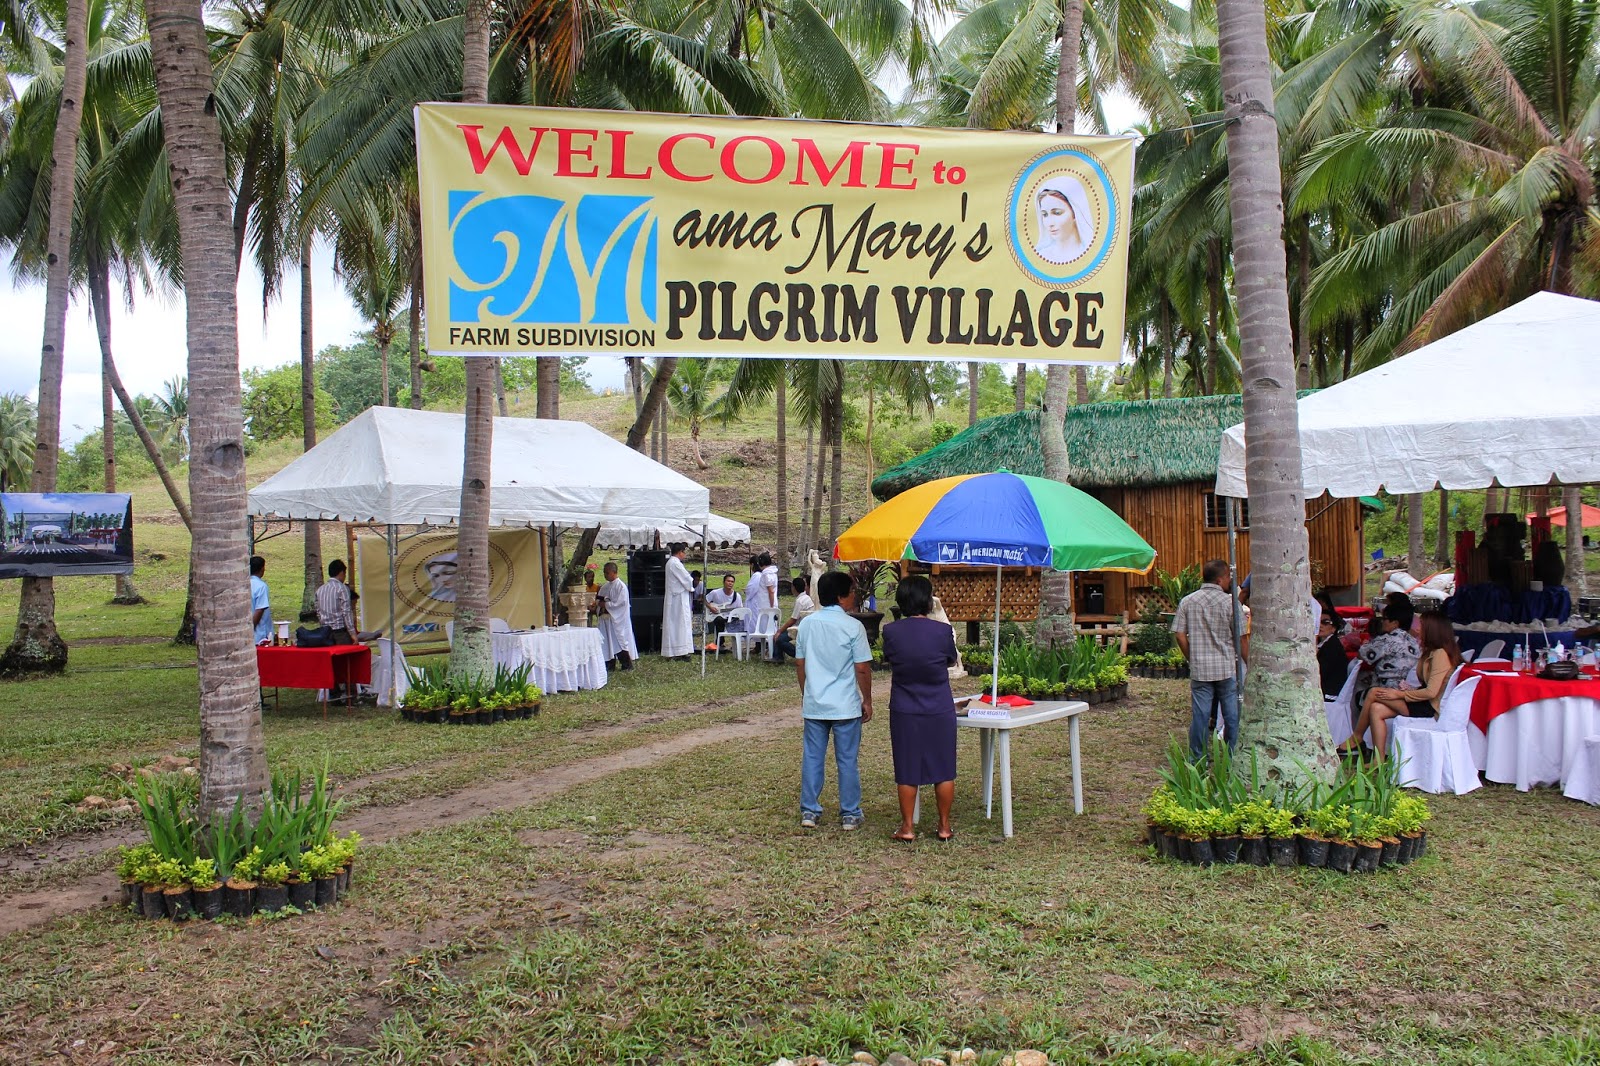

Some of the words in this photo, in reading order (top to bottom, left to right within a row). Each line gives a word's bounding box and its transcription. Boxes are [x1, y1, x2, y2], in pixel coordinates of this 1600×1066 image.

[457, 124, 920, 190] WELCOME
[932, 160, 967, 185] to
[784, 192, 993, 280] Mary's
[449, 327, 510, 346] FARM
[517, 328, 656, 347] SUBDIVISION
[665, 281, 879, 344] PILGRIM
[891, 285, 1104, 349] VILLAGE
[961, 542, 1002, 560] AMERICAN
